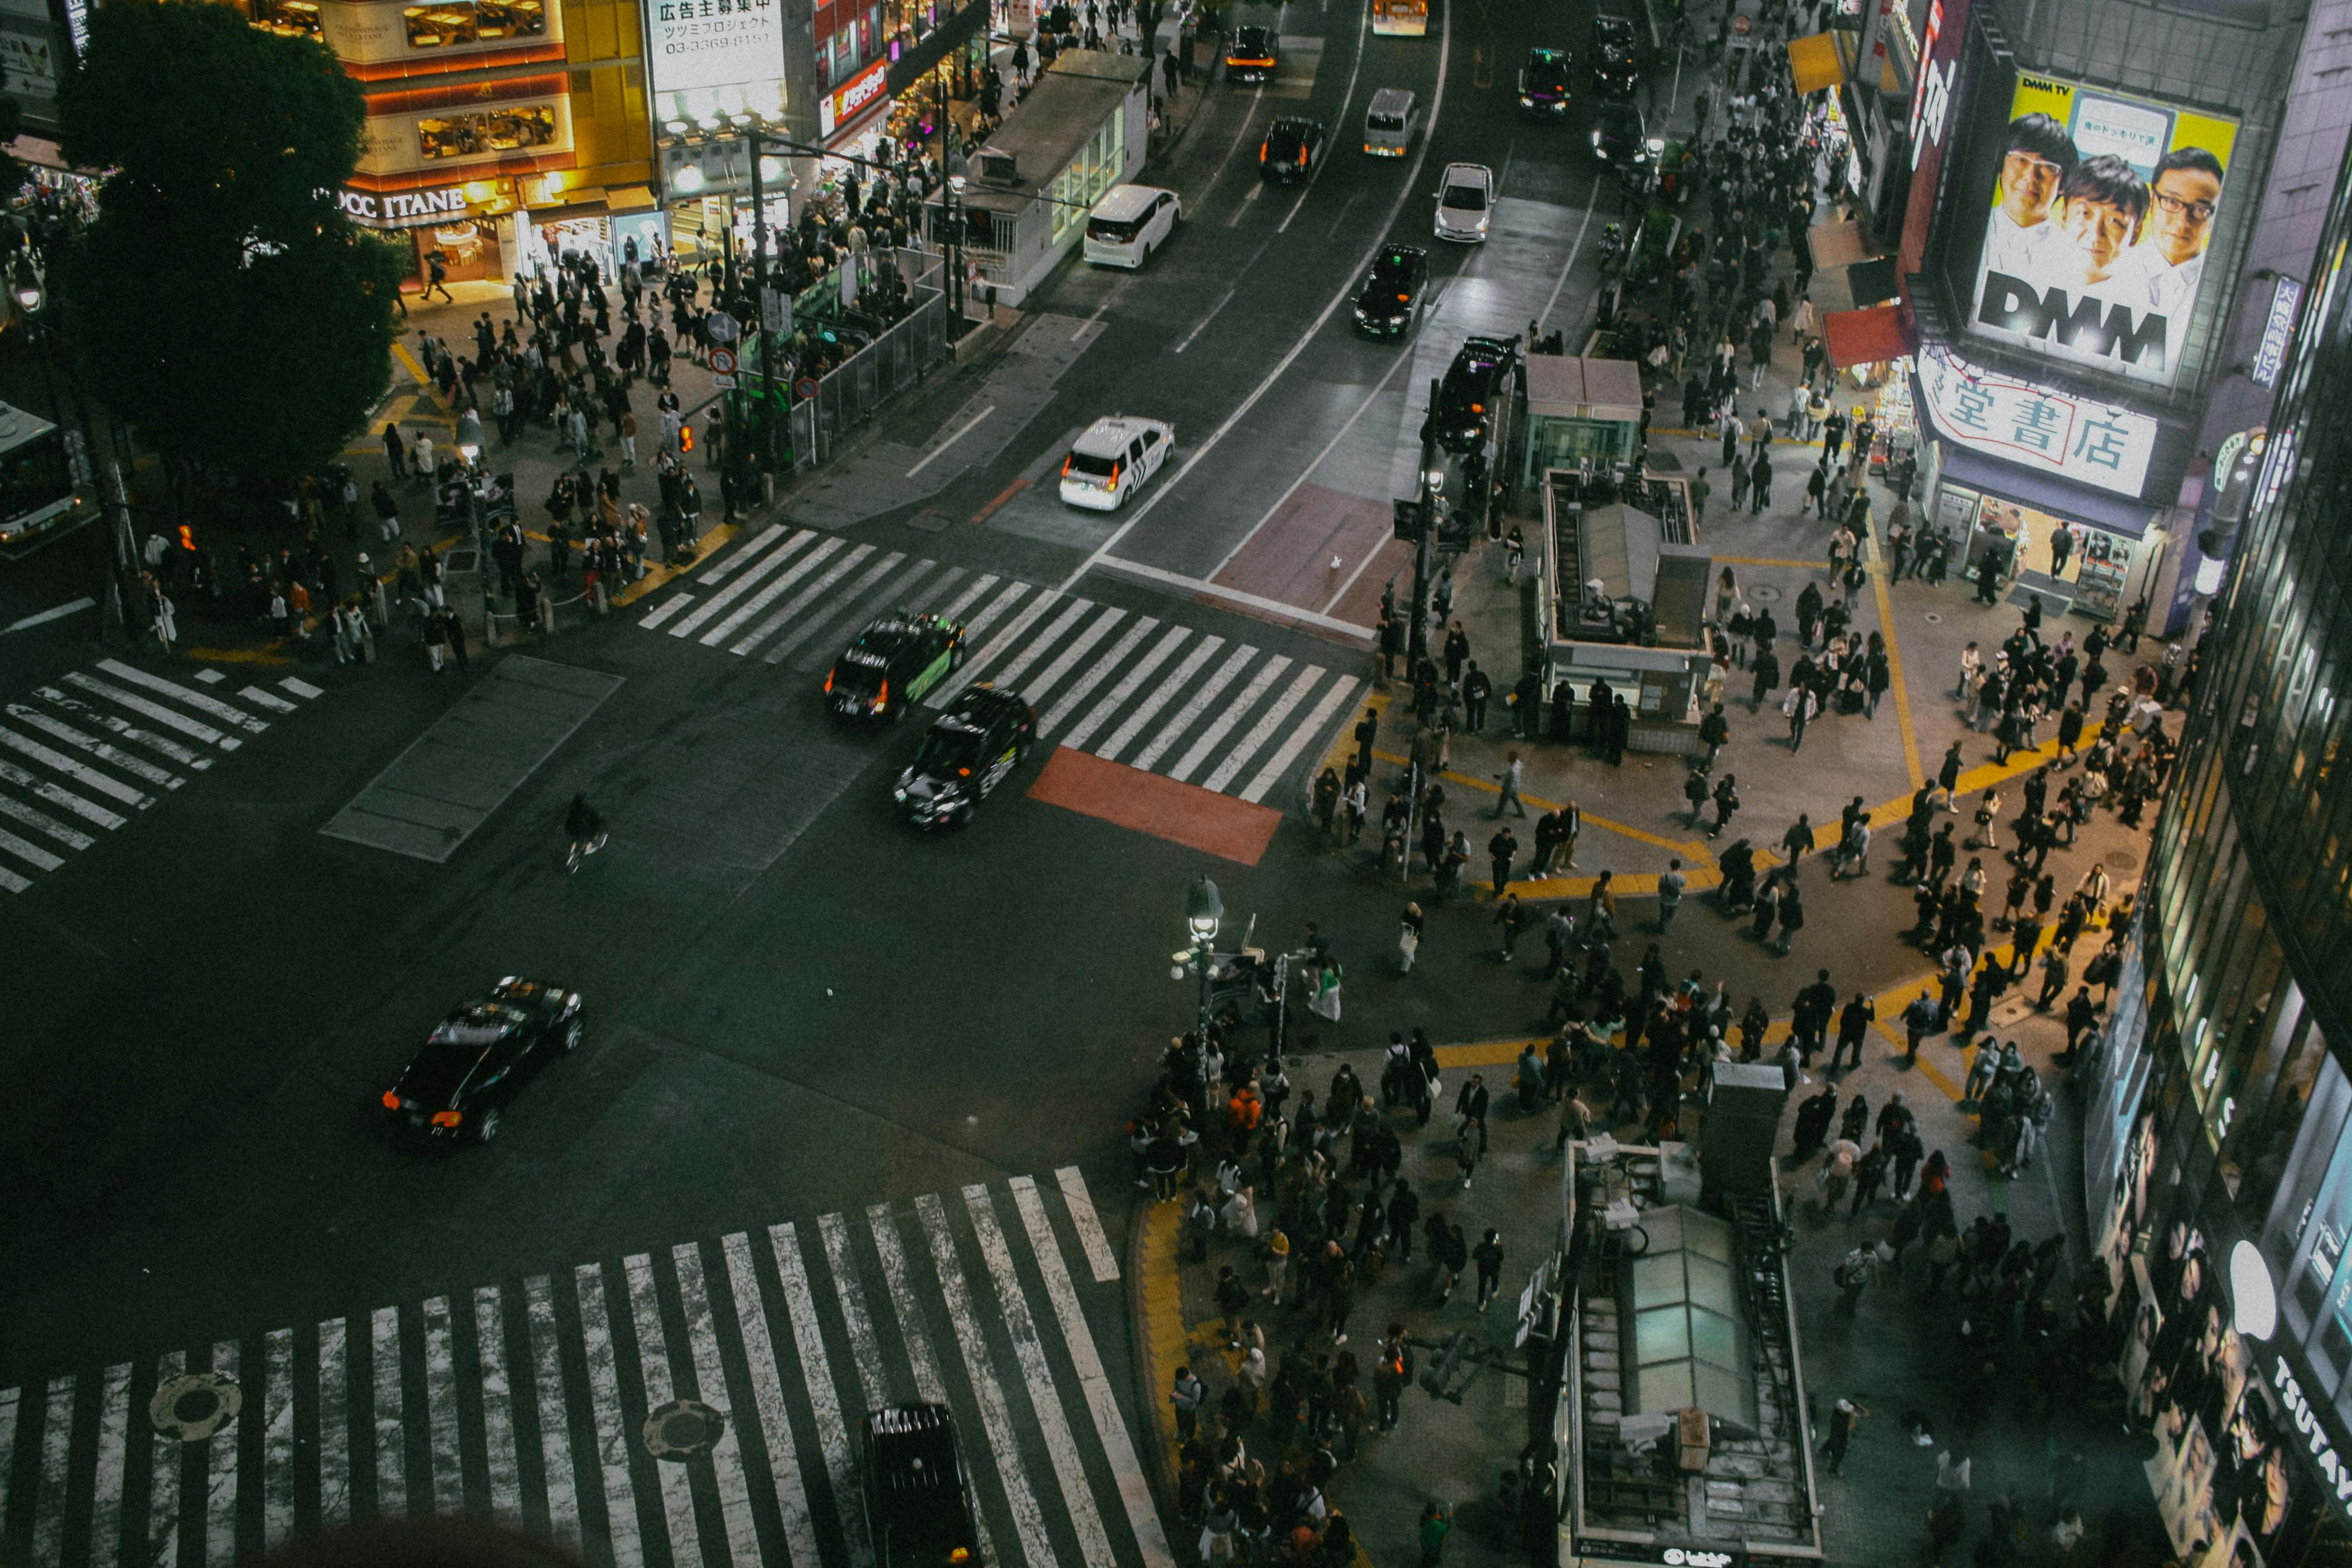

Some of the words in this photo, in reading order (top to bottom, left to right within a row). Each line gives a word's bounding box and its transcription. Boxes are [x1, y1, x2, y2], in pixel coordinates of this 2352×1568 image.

[660, 0, 770, 22] 広告主募集中
[665, 16, 769, 39] ツツミプロジェクト
[2022, 77, 2053, 93] DMM
[2055, 85, 2070, 96] TV
[312, 187, 466, 218] OCCITANE
[1978, 269, 2168, 373] DMM
[2275, 1355, 2352, 1516] TSUTAY
